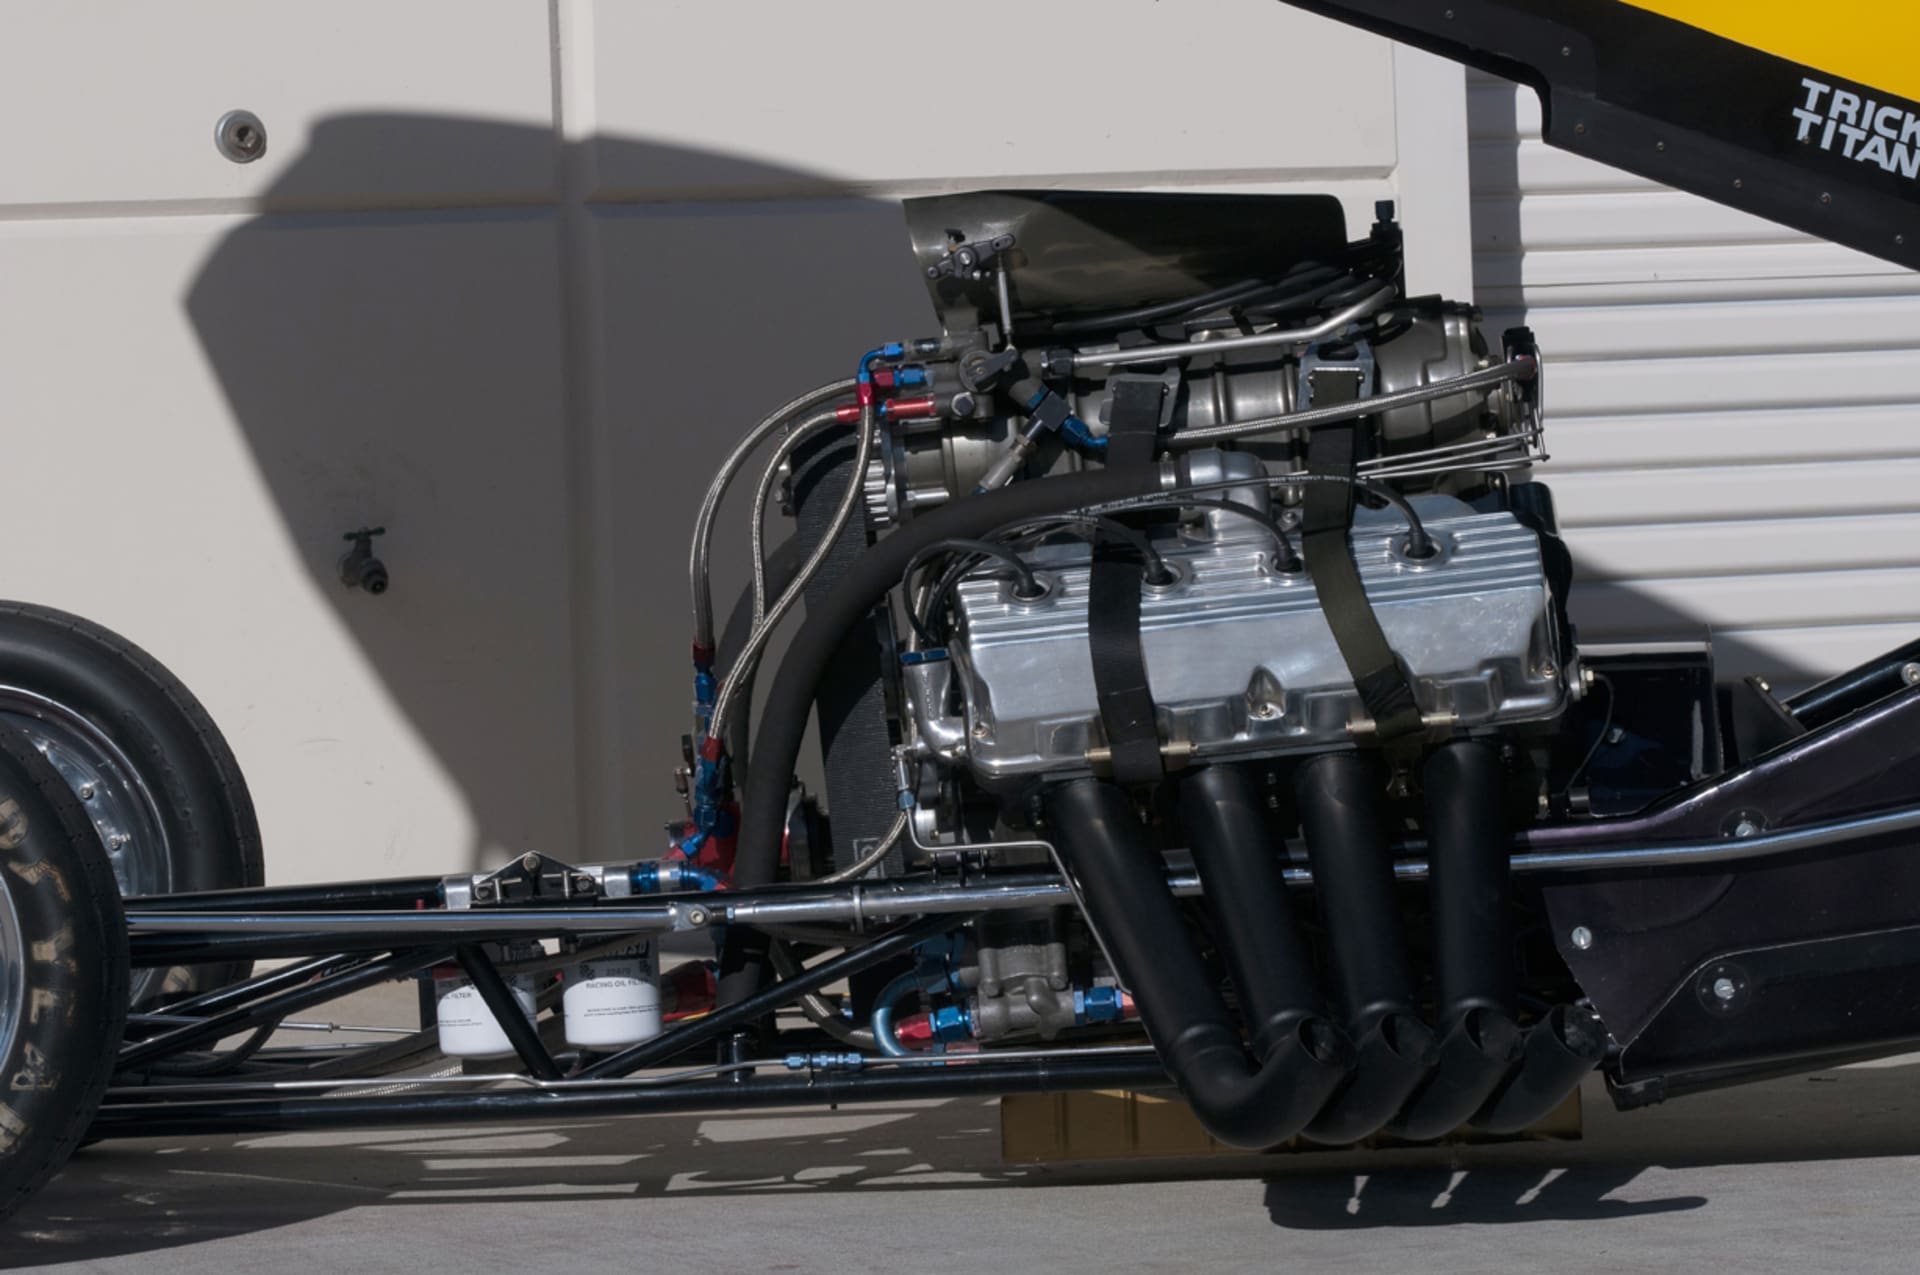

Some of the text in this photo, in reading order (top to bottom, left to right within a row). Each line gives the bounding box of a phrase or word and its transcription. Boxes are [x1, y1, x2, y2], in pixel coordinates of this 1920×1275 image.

[1792, 107, 1920, 179] TITAN
[1801, 77, 1920, 149] TRICK
[586, 980, 613, 989] RACING
[614, 980, 626, 988] OIL
